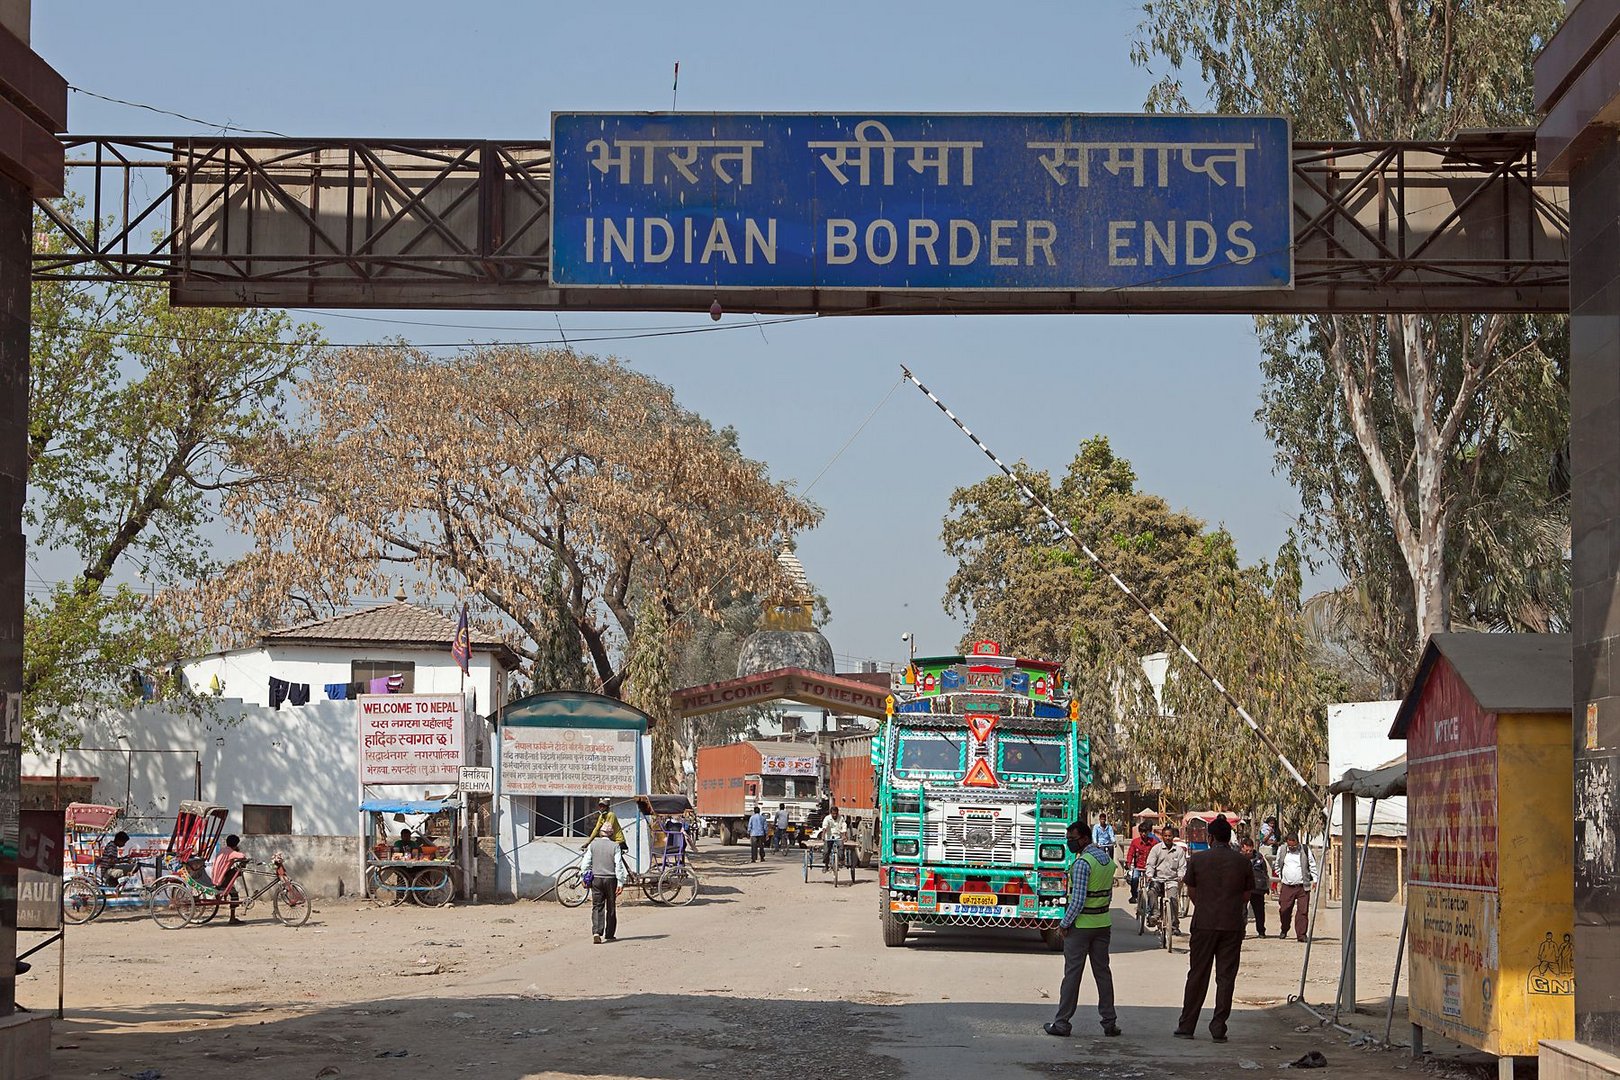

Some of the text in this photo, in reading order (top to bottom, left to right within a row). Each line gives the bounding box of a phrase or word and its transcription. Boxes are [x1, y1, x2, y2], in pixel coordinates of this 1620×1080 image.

[585, 120, 1256, 189] भारत सीमा समाप्त
[585, 217, 1258, 268] INDIAN BORDER ENDS
[681, 680, 775, 711] WELCOME
[800, 681, 826, 696] TO
[363, 701, 458, 714] WELCOME TO NEPAL
[371, 719, 389, 729] यस
[391, 719, 420, 728] नगरमा
[1434, 716, 1459, 742] NOTICE
[365, 731, 396, 748] हार्दिक
[398, 733, 434, 745] स्वागत
[414, 748, 460, 760] नगरपालिका
[462, 768, 490, 779] बेलहिया
[460, 782, 491, 791] BELHIYA
[953, 904, 1003, 915] INDIAN
[1455, 916, 1477, 939] Booth
